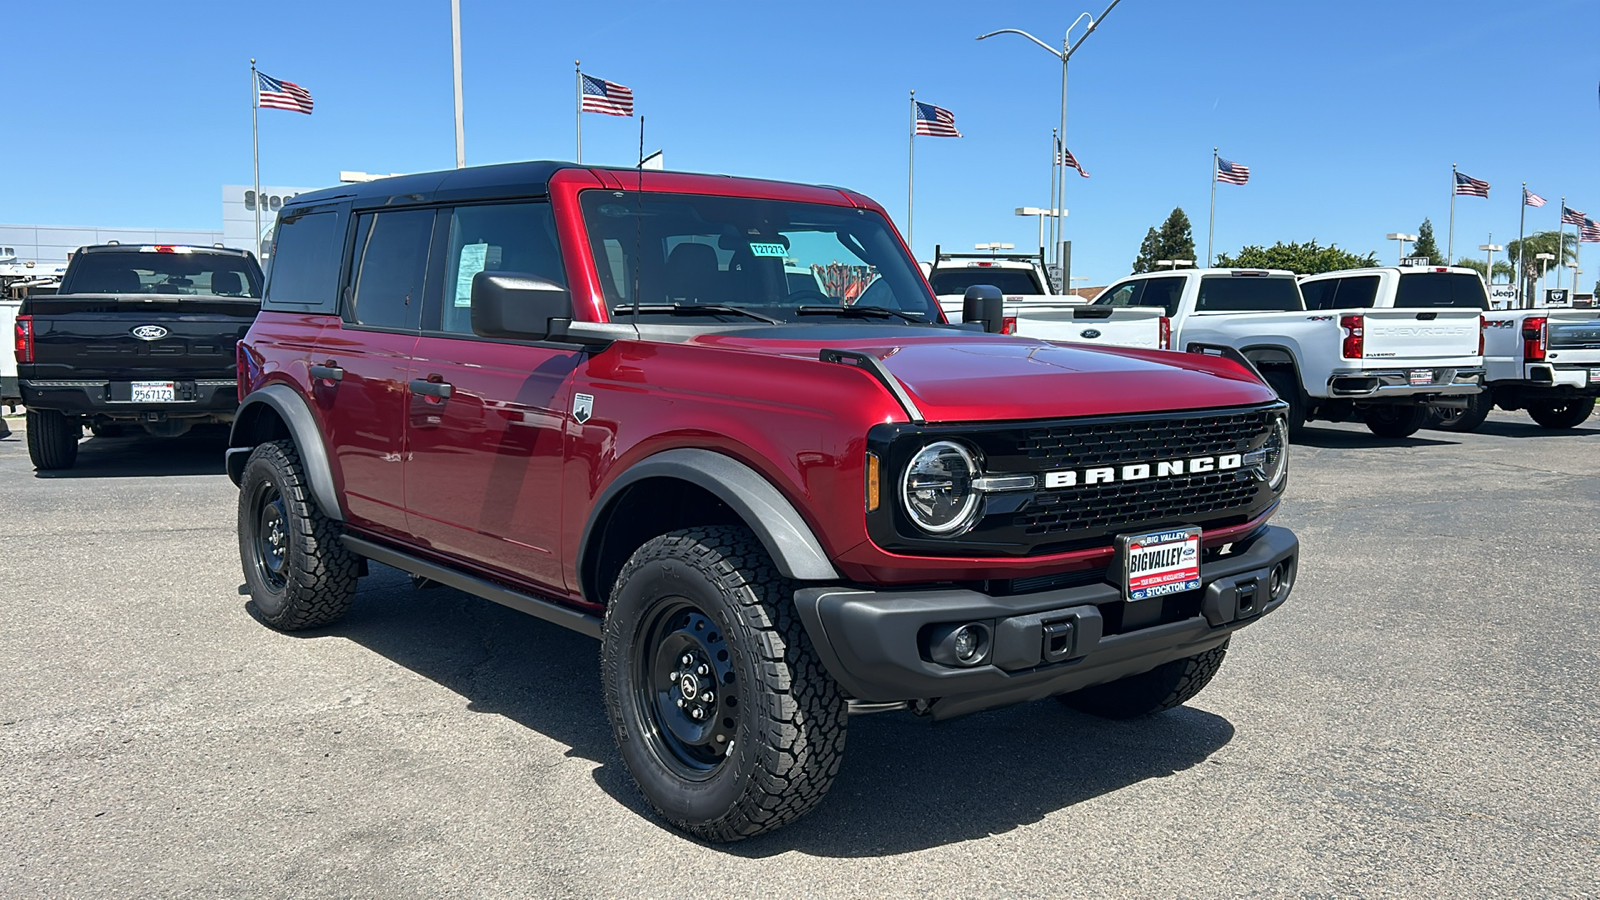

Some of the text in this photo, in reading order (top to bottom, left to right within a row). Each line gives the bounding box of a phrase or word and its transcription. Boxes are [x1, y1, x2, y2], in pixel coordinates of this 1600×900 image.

[245, 190, 298, 211] Stoc
[751, 244, 785, 255] T27273
[1492, 289, 1515, 298] Jeep
[136, 326, 165, 338] Ford
[1373, 327, 1474, 337] CHEVROLET
[1045, 453, 1242, 488] BRONCO
[1146, 532, 1186, 544] BIG VALLEY
[1130, 547, 1183, 573] BIGVALLEY
[1146, 581, 1186, 597] STOCKTON
